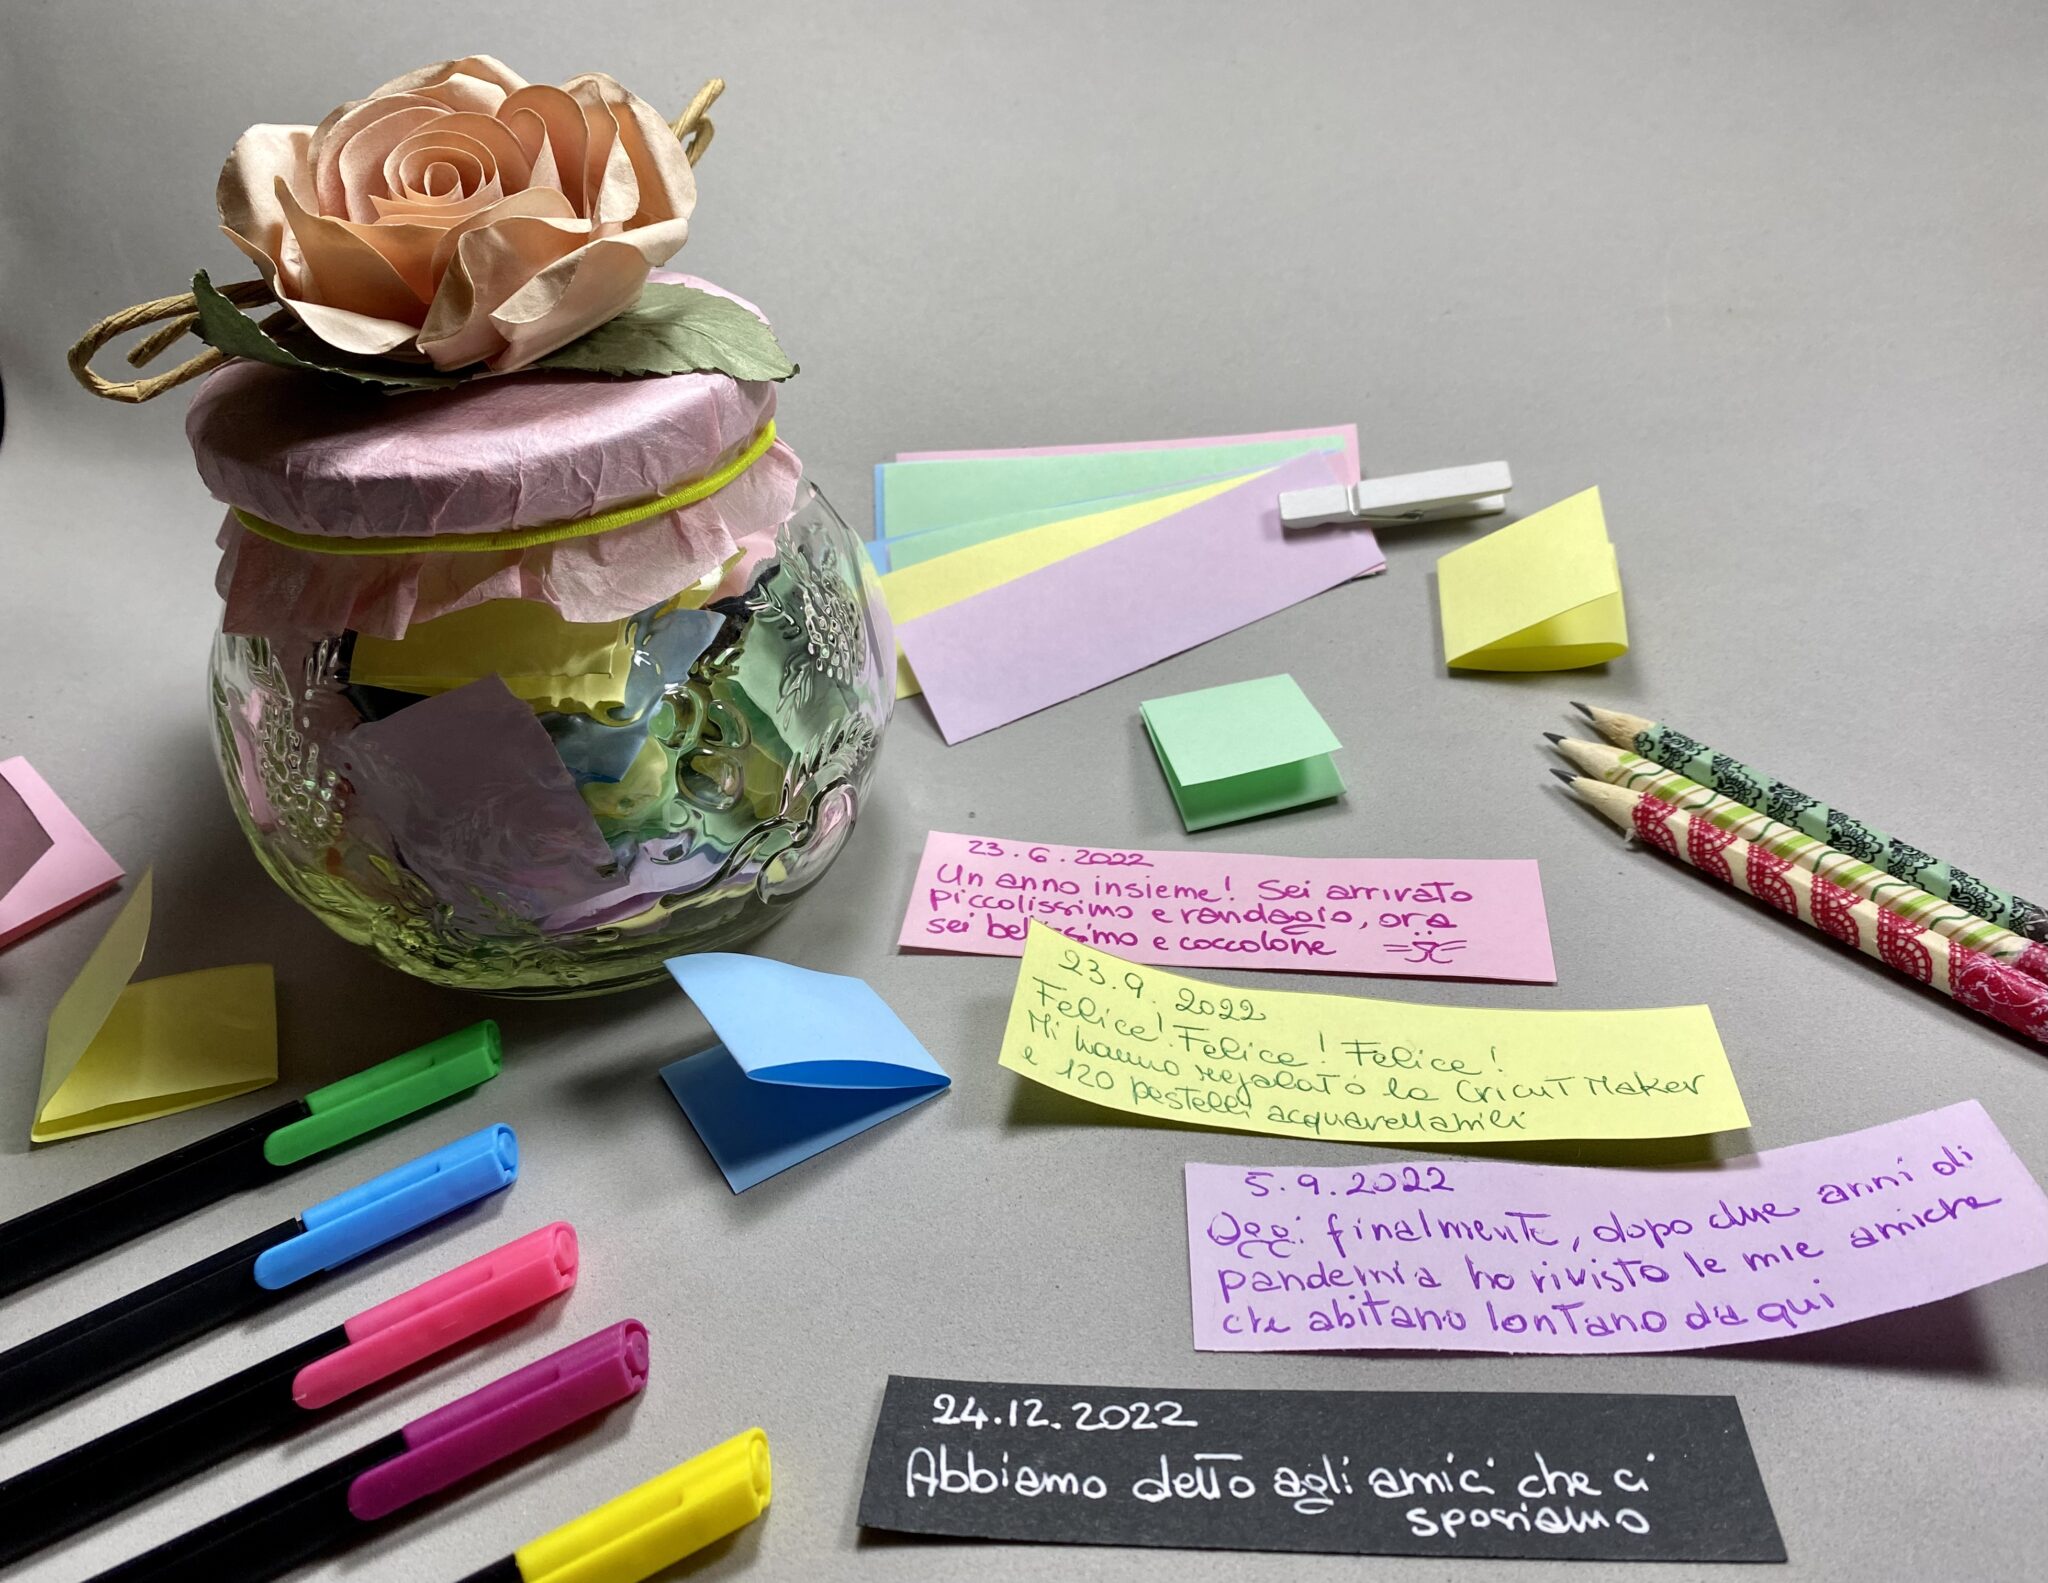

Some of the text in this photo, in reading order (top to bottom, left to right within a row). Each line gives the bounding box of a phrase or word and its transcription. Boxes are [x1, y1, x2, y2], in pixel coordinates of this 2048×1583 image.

[936, 863, 983, 887] Un
[995, 871, 1080, 895] anno
[1257, 879, 1311, 900] Sei
[1326, 881, 1473, 903] arrivato
[929, 888, 1133, 920] piccolissimo
[1151, 907, 1173, 924] e
[1378, 911, 1458, 928] ora
[926, 912, 975, 934] sei
[1152, 935, 1169, 951] e
[1179, 930, 1337, 955] coccolone
[1024, 1046, 1037, 1066] e
[1056, 1059, 1114, 1090] 120
[1028, 1009, 1060, 1040] Mi
[1075, 1025, 1180, 1077] hanno
[1383, 1077, 1440, 1101] la
[1456, 1075, 1577, 1103] Cricut
[1583, 1070, 1705, 1097] Maker
[1206, 1211, 1304, 1259] Oggi
[1592, 1210, 1694, 1249] dopo
[1816, 1156, 1914, 1205] anni
[1932, 1145, 1974, 1176] di
[1217, 1196, 2003, 1303] pandemia ho rivisto le mie amiche
[1222, 1304, 1292, 1335] che
[1308, 1289, 1467, 1333] abitano
[1485, 1300, 1668, 1337] lontano
[1756, 1278, 1835, 1330] qui
[932, 1393, 1199, 1432] 24.12.2022
[905, 1443, 1656, 1516] Abbiamo detto agli amici che ci
[1406, 1502, 1651, 1538] sposiamo
